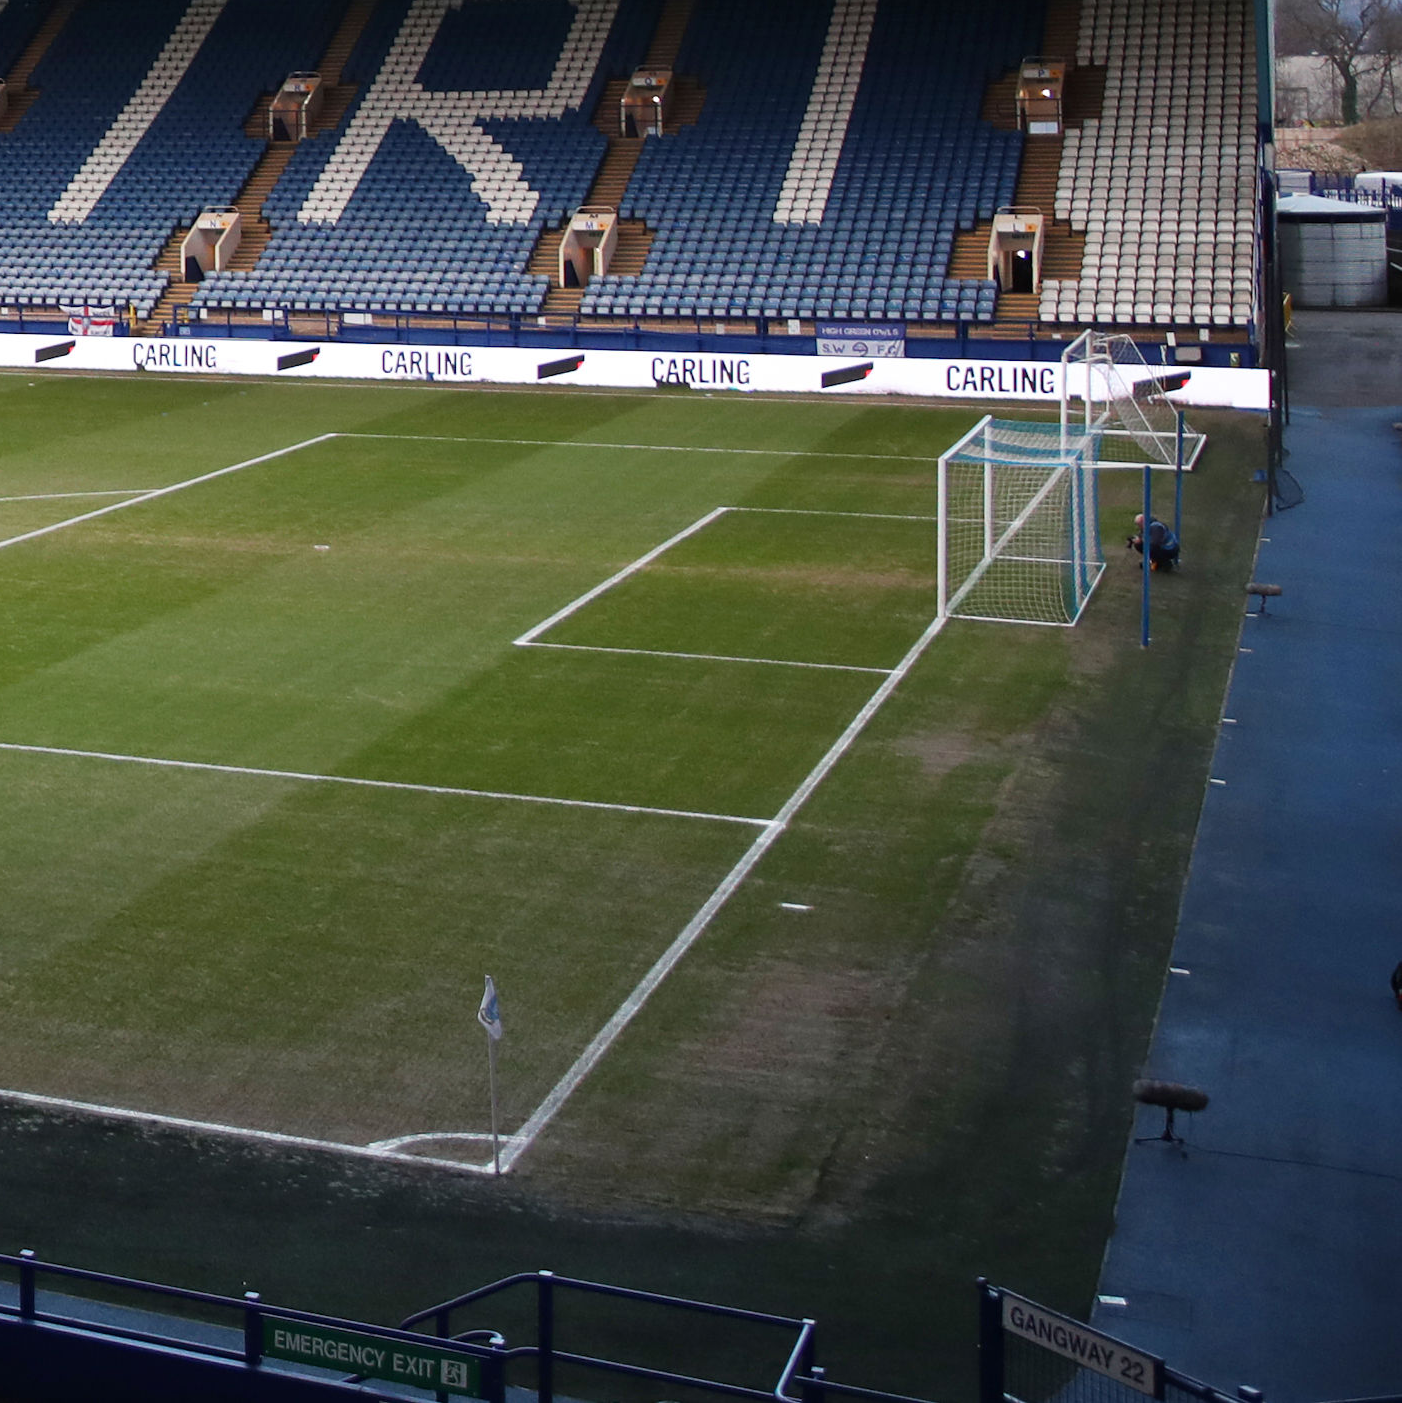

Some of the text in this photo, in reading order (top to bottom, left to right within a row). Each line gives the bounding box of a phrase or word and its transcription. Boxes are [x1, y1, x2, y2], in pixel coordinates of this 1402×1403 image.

[133, 343, 217, 369] CARLING
[382, 350, 472, 377] CARLING
[652, 358, 750, 386] CARLING
[946, 365, 1054, 394] CARLING
[274, 1329, 435, 1379] EMERGENCY EXIT
[1010, 1307, 1145, 1384] GANGWAY 22
